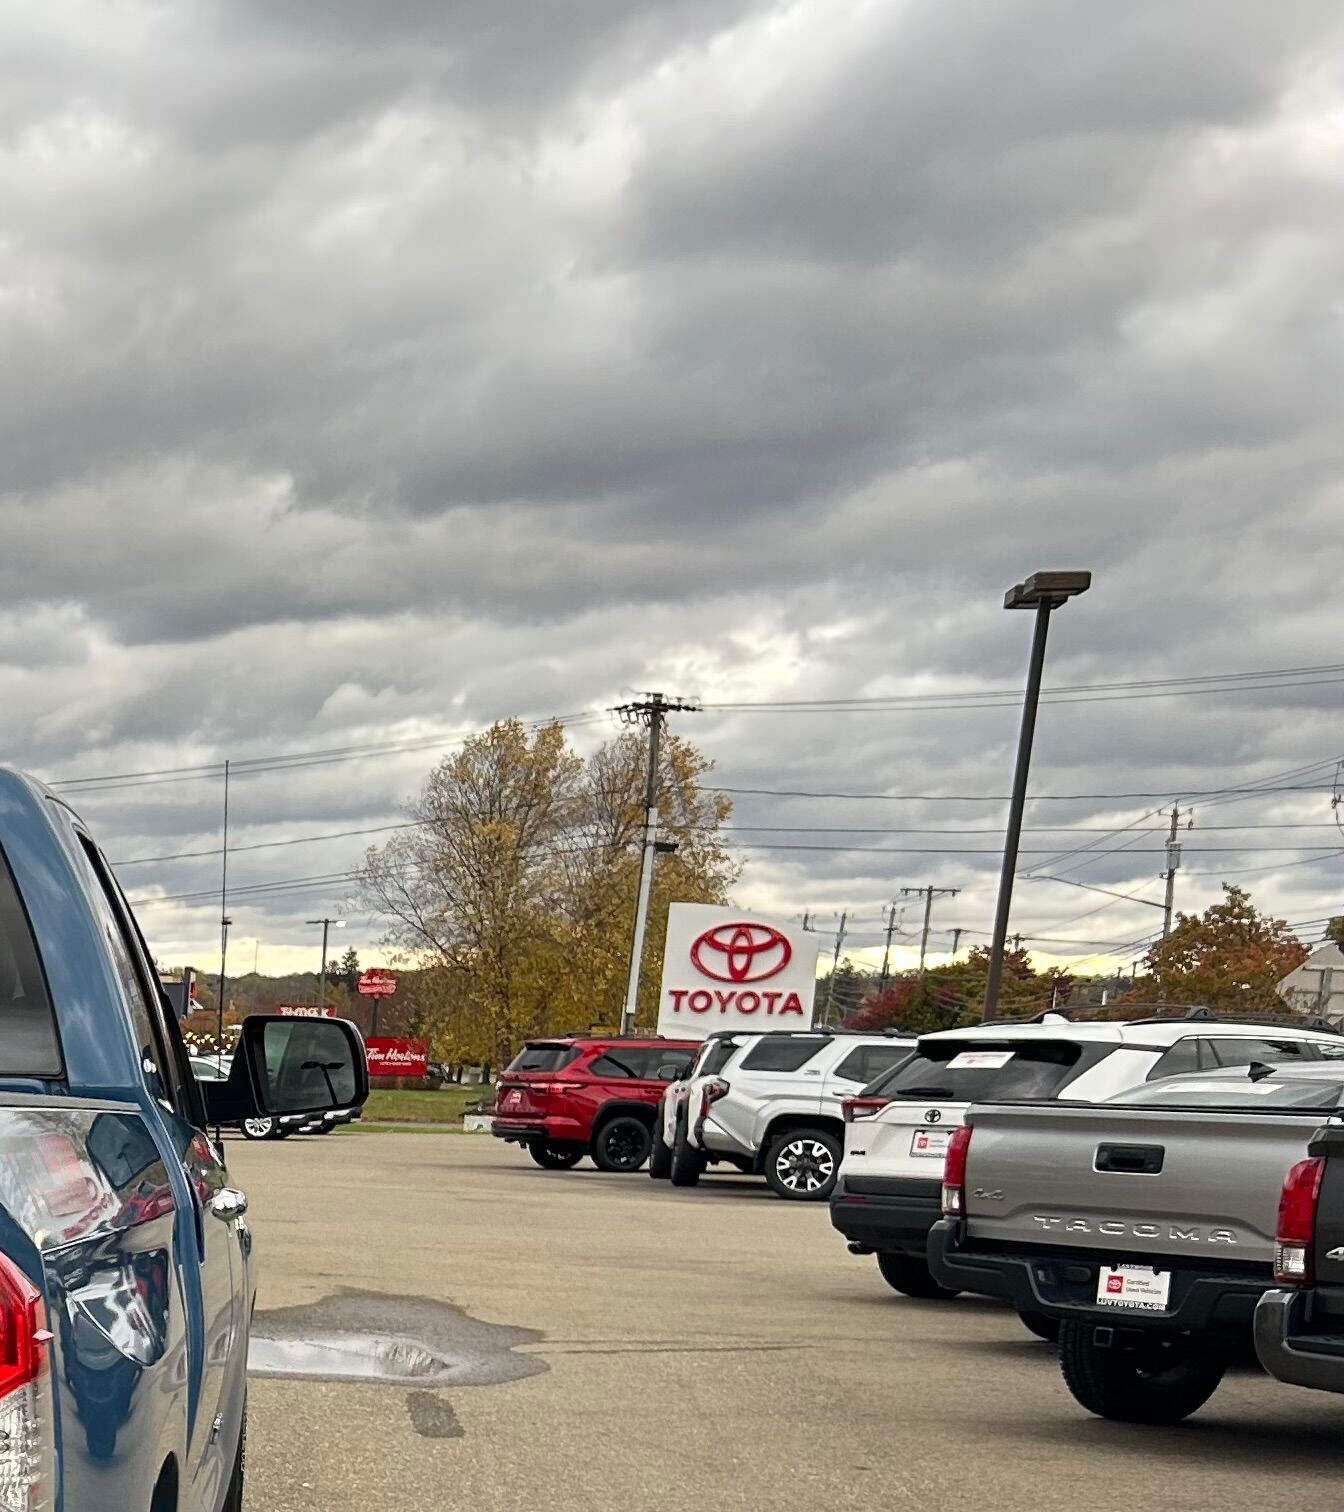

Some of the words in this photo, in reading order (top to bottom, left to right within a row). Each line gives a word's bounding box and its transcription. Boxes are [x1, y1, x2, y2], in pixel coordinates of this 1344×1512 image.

[668, 989, 804, 1015] TOYOTA
[366, 1047, 385, 1061] Tim
[386, 1047, 425, 1062] Hortons
[1033, 1214, 1238, 1244] TACOMA
